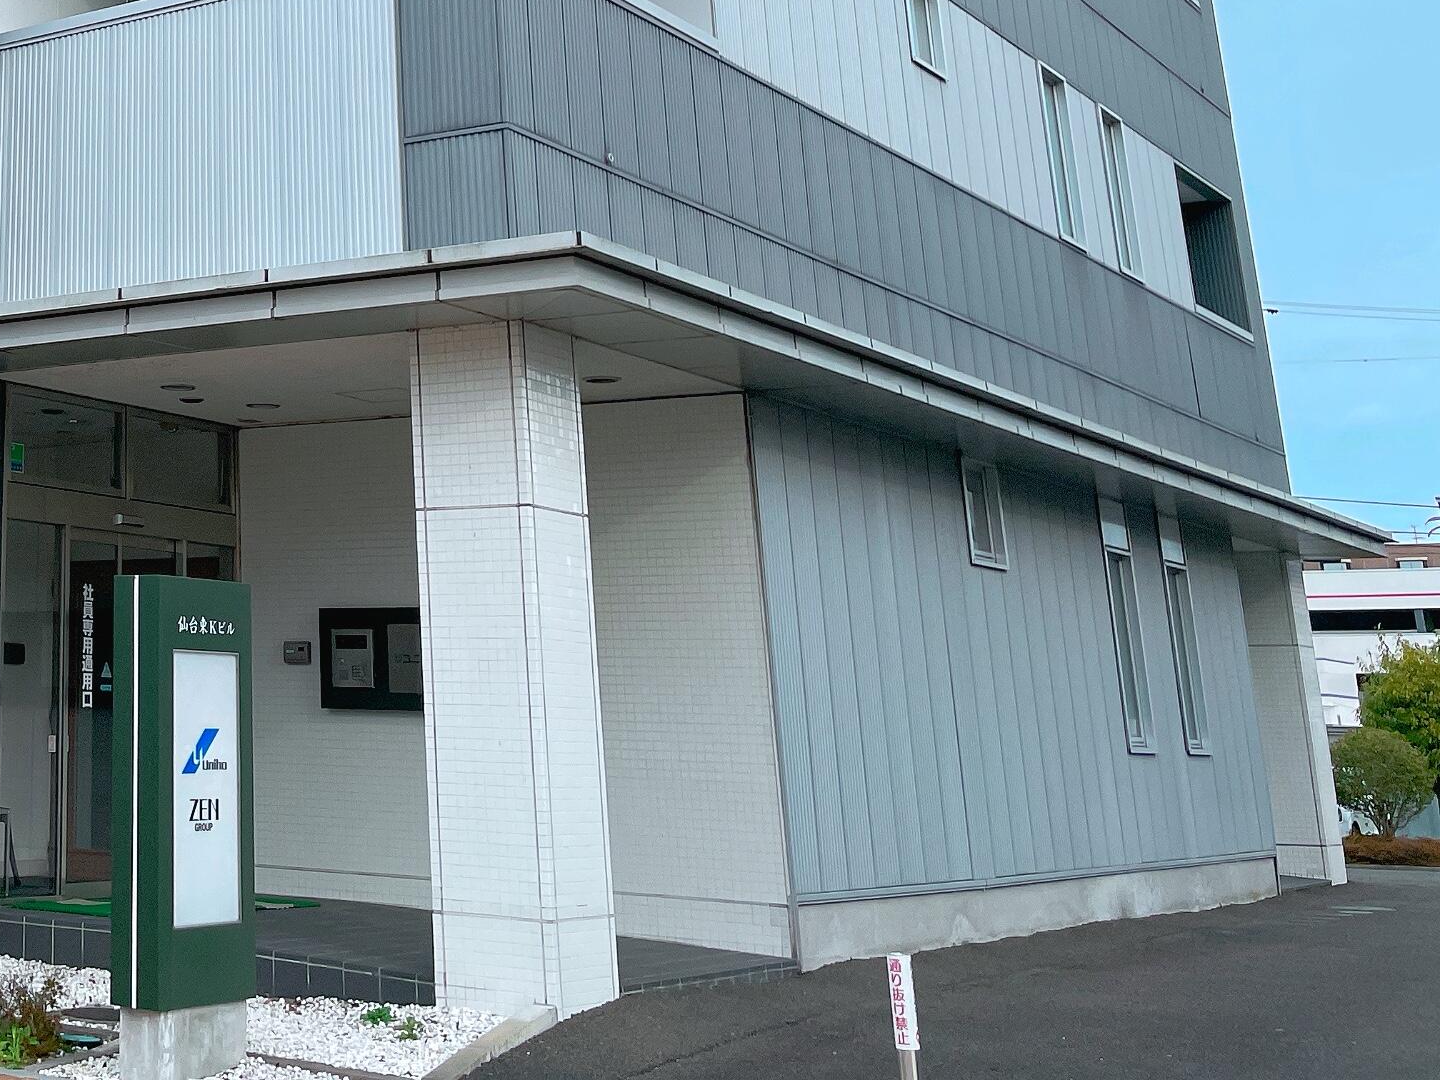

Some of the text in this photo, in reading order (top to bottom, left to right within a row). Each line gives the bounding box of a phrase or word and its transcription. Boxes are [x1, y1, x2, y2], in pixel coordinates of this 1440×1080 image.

[177, 615, 236, 635] 仙台東Kビル
[81, 583, 94, 708] 社員専用通用口
[202, 758, 228, 771] Uniho
[189, 798, 220, 822] ZEN
[194, 822, 214, 832] GROUP
[889, 958, 910, 1046] 通り抜け禁止
